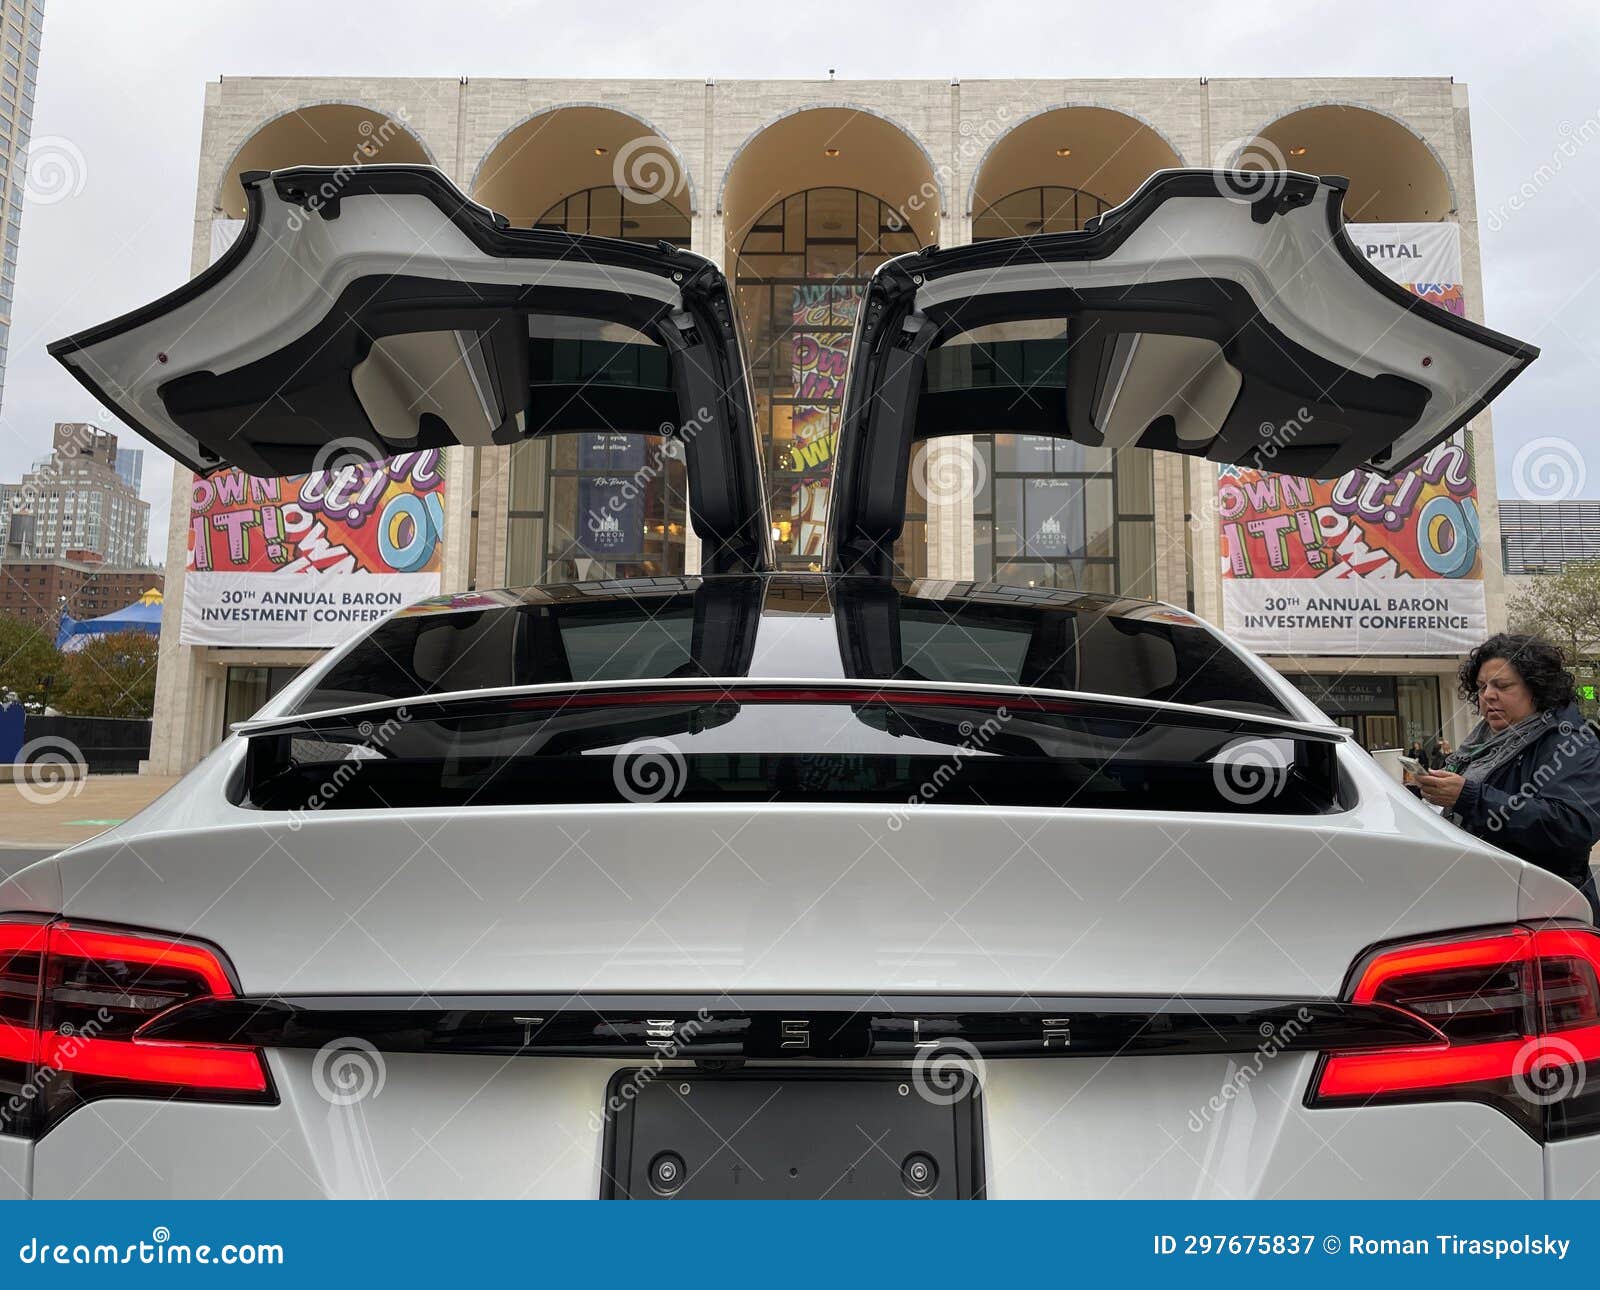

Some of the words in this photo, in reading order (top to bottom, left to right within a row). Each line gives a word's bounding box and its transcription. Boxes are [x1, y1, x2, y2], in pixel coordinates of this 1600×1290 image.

[1356, 244, 1422, 258] PITAL
[191, 472, 281, 514] OWN
[1219, 474, 1313, 520] OWN
[192, 505, 289, 573] IT!
[1222, 510, 1328, 579] IT!
[221, 591, 256, 604] 30TH
[261, 592, 336, 605] ANNUAL
[342, 592, 401, 605] BARON
[1265, 598, 1300, 611] 30TH
[1306, 598, 1382, 611] ANNUAL
[1387, 598, 1448, 611] BARON
[201, 608, 307, 621] INVESTMENT
[313, 609, 393, 622] CONFERE
[1245, 615, 1353, 629] INVESTMENT
[1359, 616, 1468, 629] CONFERENCE
[513, 1018, 1071, 1048] TESLA
